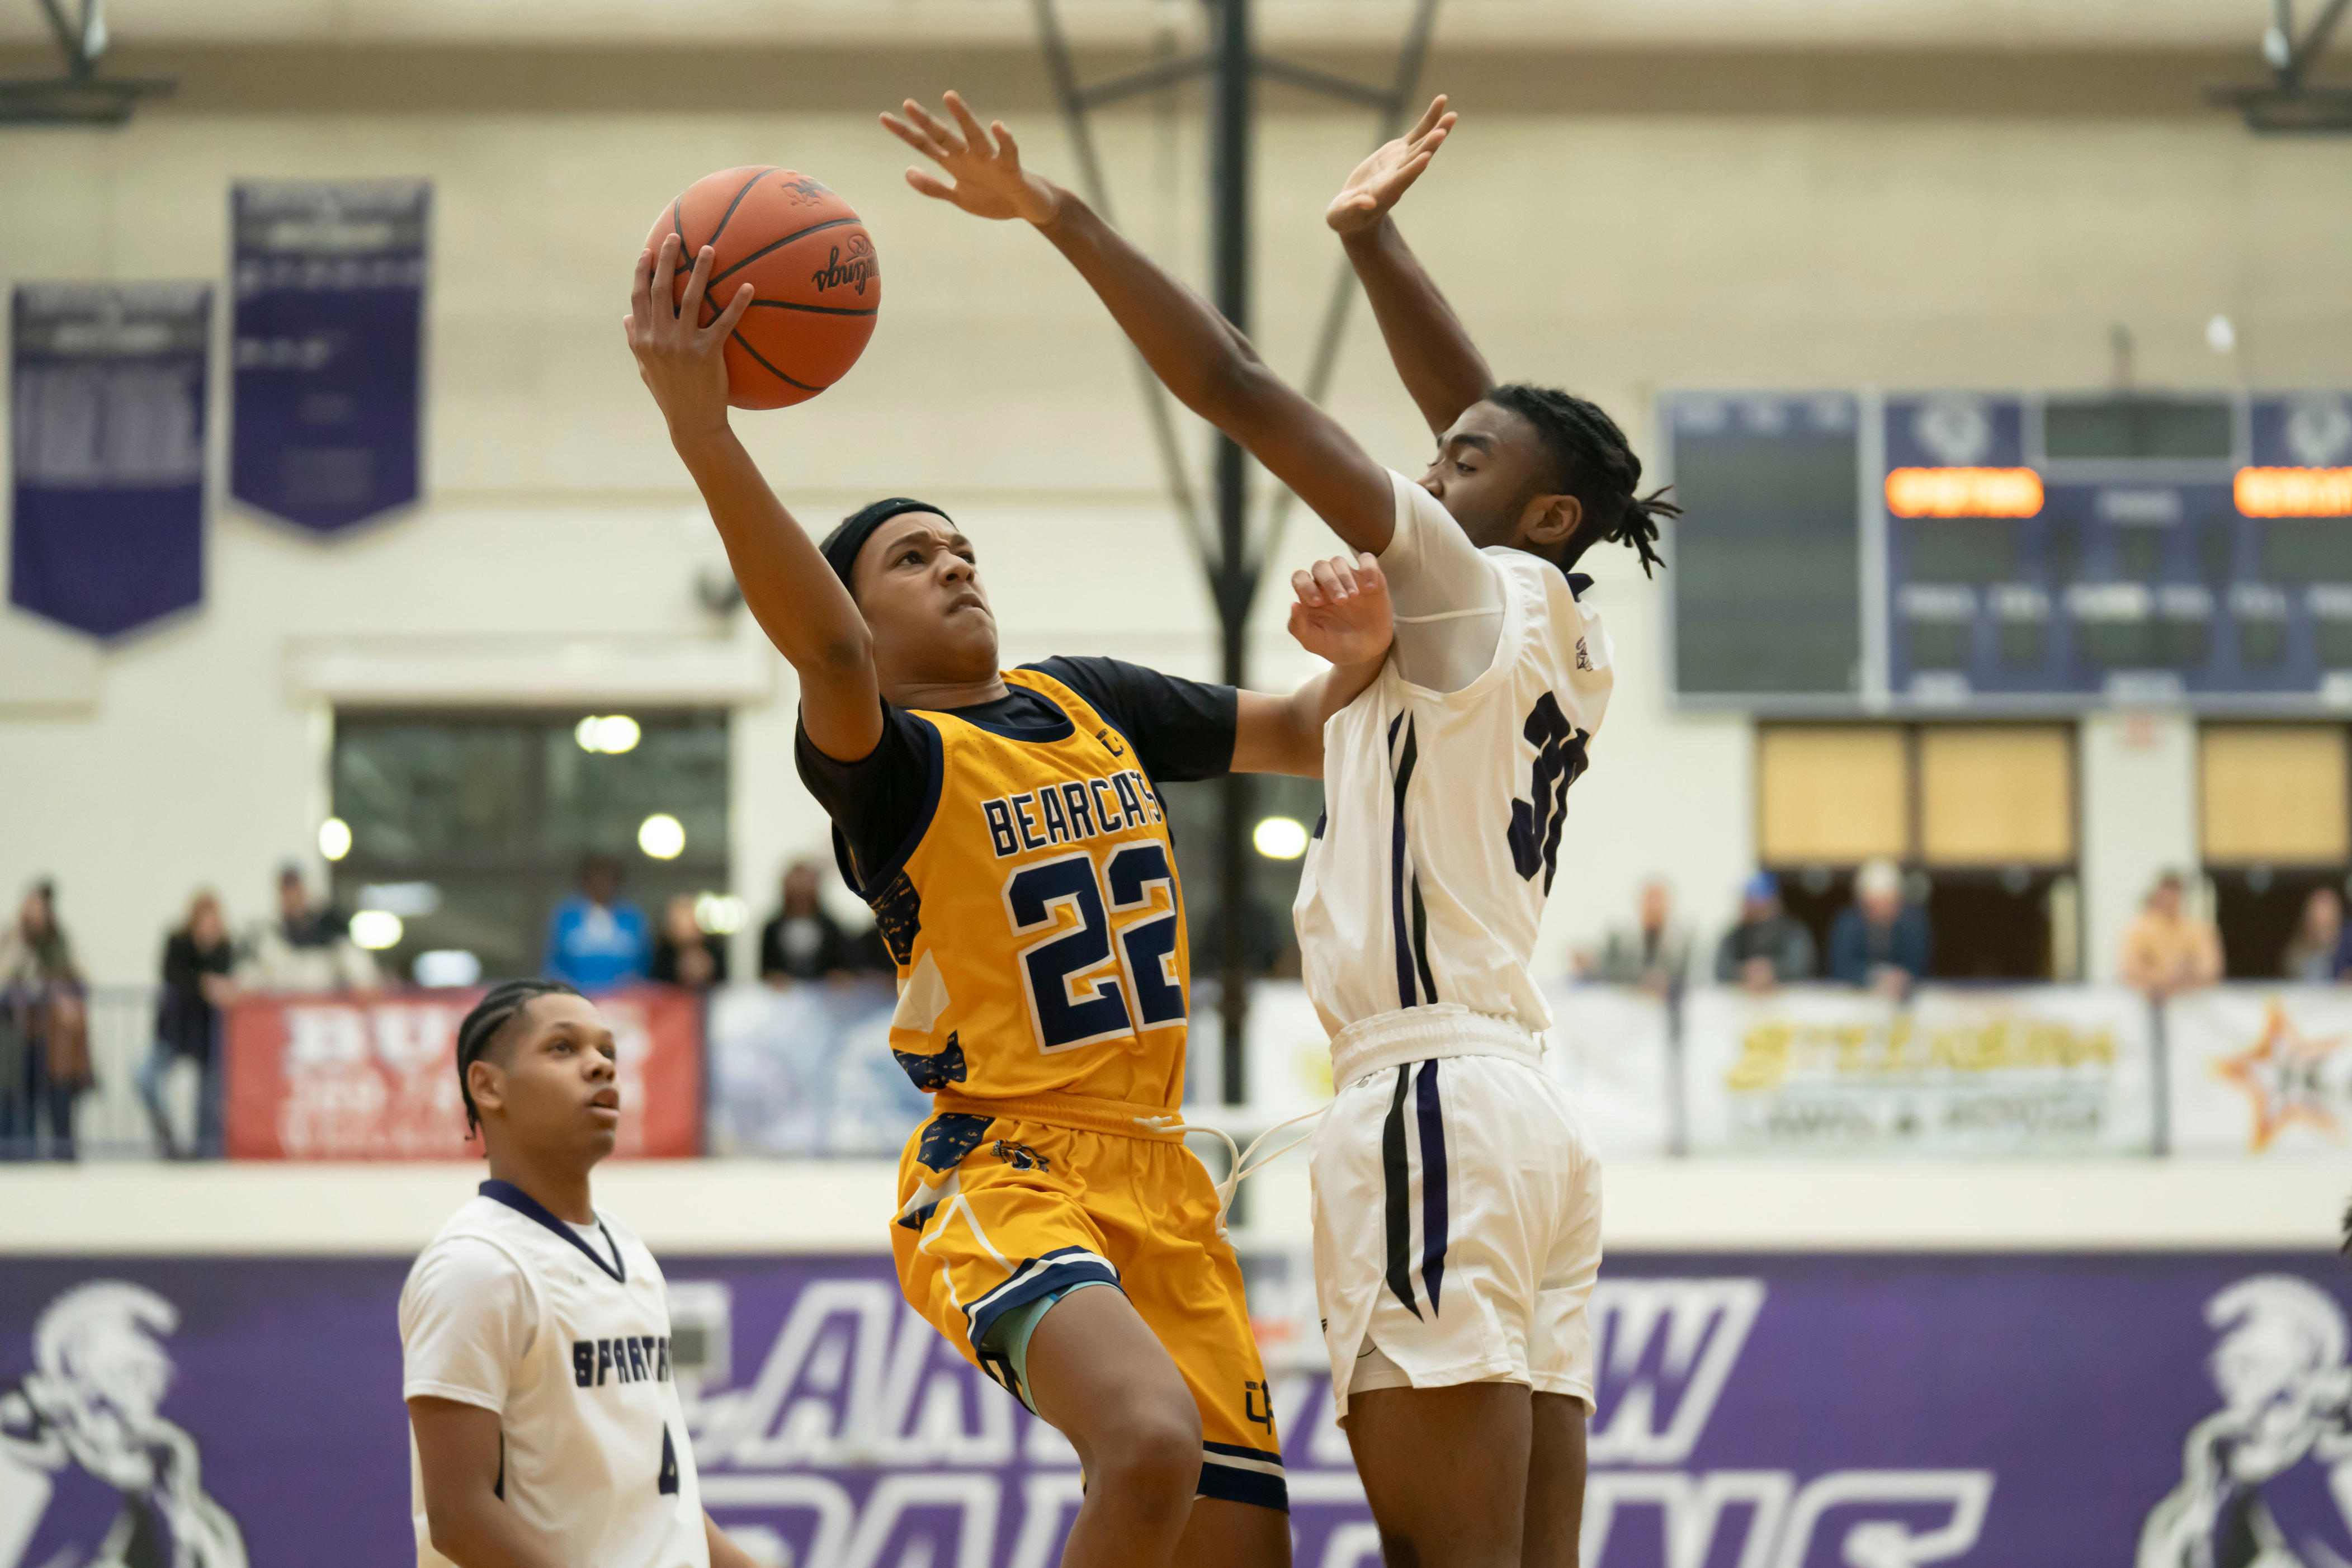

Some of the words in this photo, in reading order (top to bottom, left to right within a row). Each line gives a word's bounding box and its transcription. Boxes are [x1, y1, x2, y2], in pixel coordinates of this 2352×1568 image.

[980, 769, 1163, 859] BEARCATS
[1002, 839, 1187, 1055] 22
[573, 1336, 671, 1387] SPARTA
[659, 1420, 679, 1495] 4
